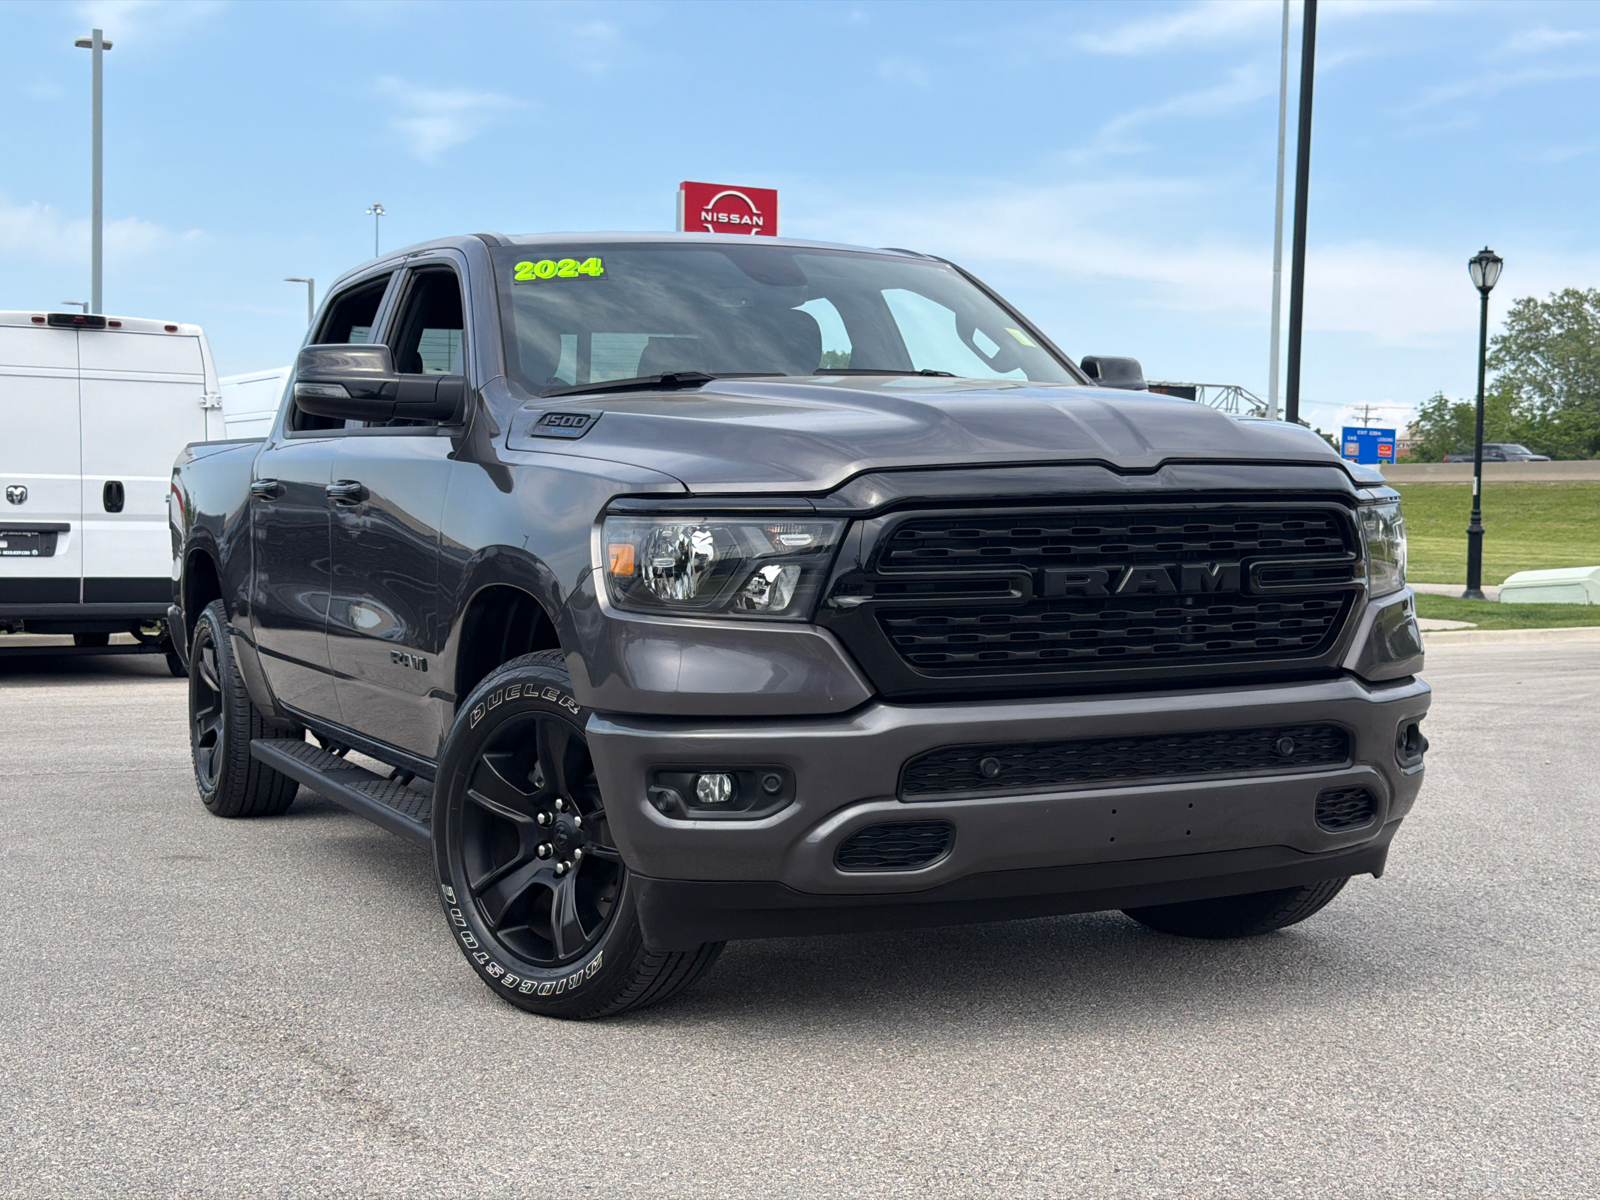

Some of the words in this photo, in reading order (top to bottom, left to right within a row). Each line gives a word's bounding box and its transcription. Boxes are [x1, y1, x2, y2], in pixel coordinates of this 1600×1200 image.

[701, 211, 763, 226] NISSAN
[514, 257, 604, 281] 2024
[543, 415, 588, 427] 1500
[1045, 562, 1241, 596] RAM
[469, 683, 580, 730] DUELER
[441, 883, 604, 996] BRIDGESTONE
